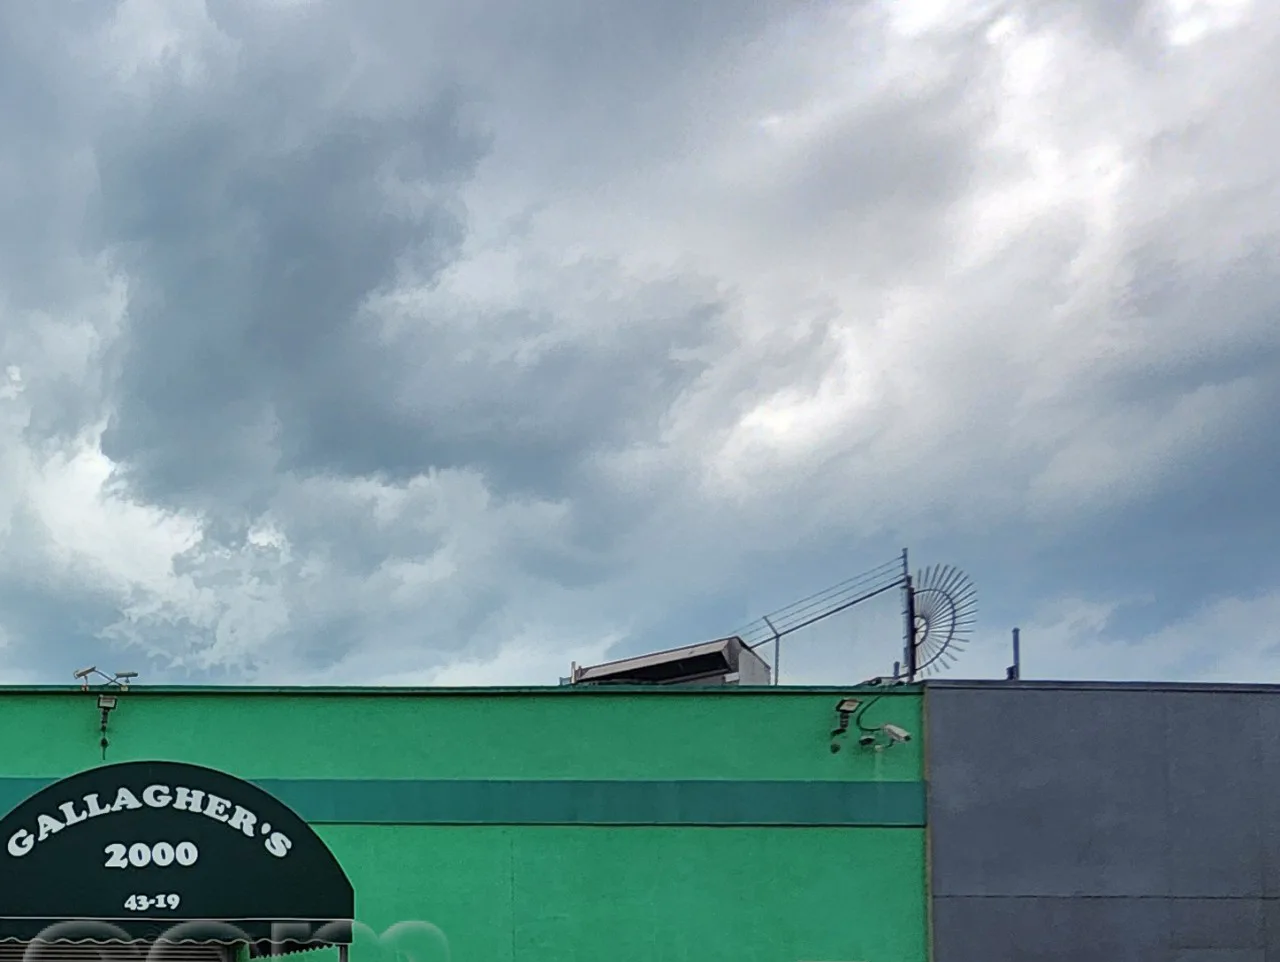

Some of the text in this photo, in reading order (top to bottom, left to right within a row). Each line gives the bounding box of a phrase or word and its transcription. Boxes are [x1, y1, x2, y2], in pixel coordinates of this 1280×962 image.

[7, 784, 293, 858] GALLAGHER'S
[104, 841, 199, 869] 2000
[123, 893, 180, 911] 43-19
